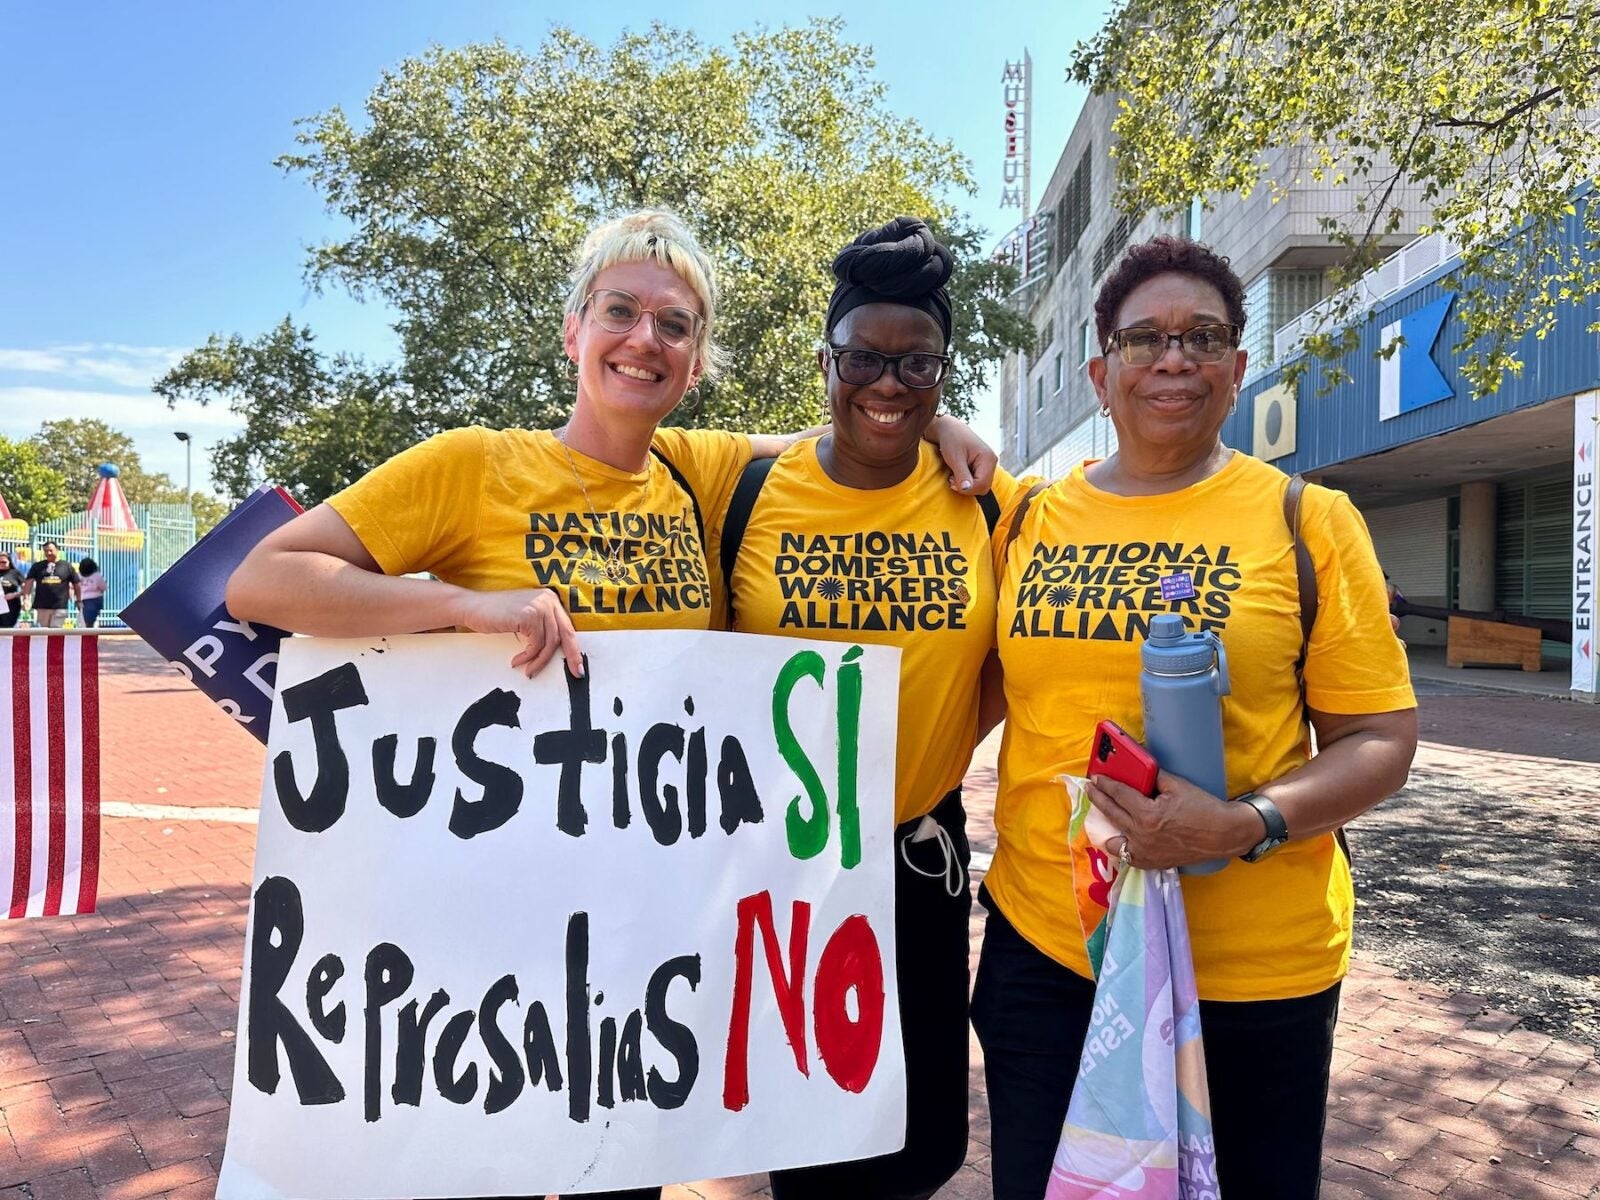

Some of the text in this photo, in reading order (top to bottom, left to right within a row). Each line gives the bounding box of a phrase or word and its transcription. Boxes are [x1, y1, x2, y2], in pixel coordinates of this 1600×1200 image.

[999, 59, 1022, 208] MUSEUM
[525, 532, 700, 564] DOMESTIC
[781, 531, 961, 555] NATIONAL
[1033, 541, 1239, 567] NATIONAL
[1575, 472, 1592, 631] ENTRANCE
[774, 554, 968, 578] DOMESTIC
[1021, 559, 1242, 591] DOMESTIC
[779, 577, 967, 602] WORKERS
[779, 601, 967, 631] ALLIANCE
[772, 645, 863, 870] SÍ
[722, 889, 885, 1111] NO
